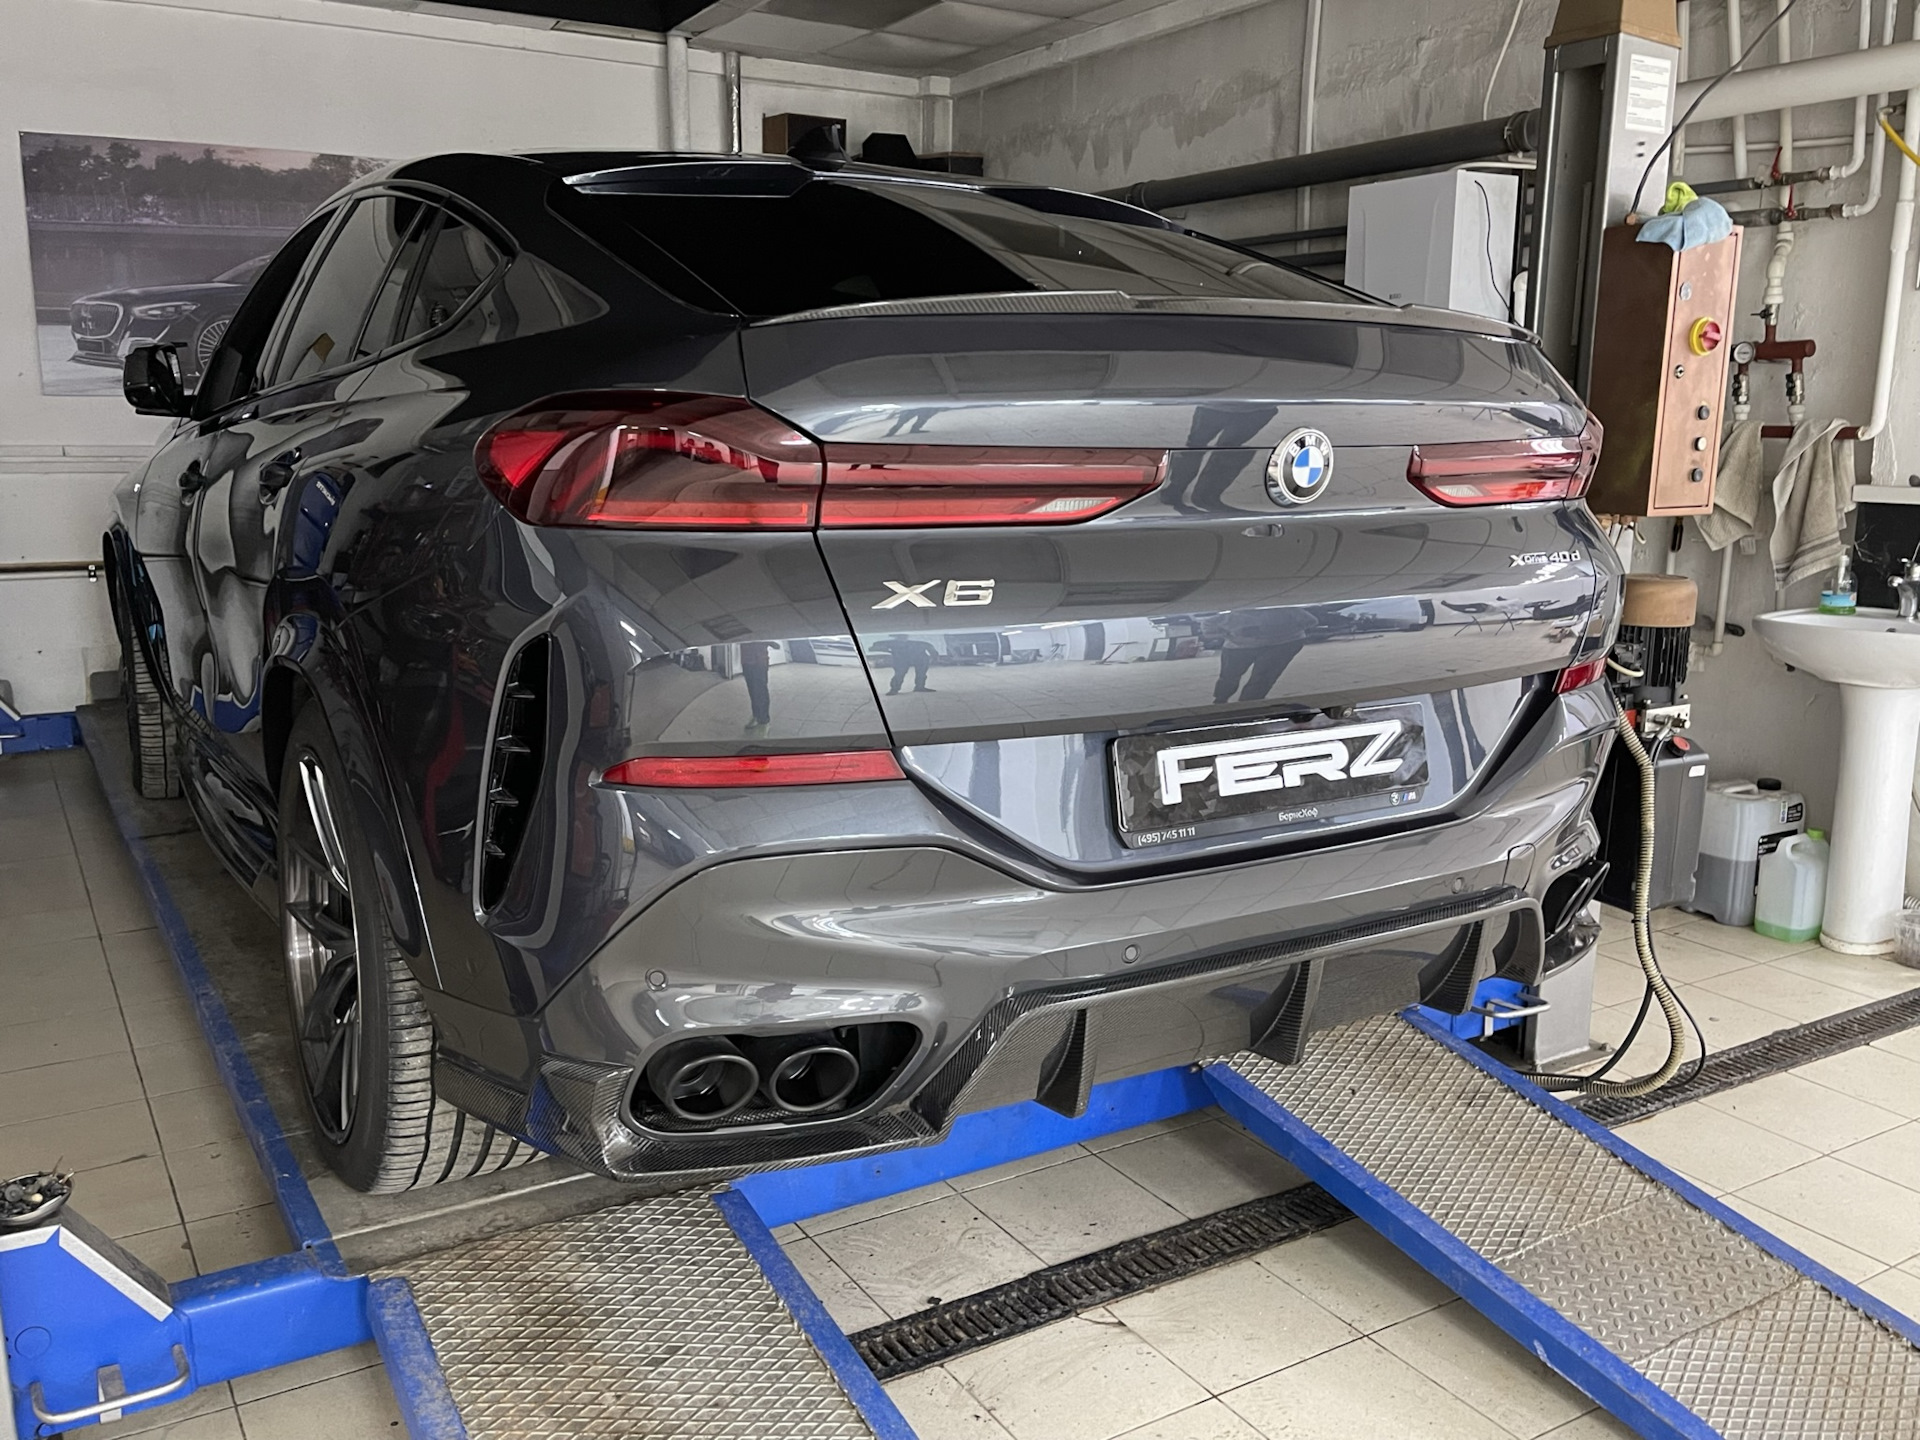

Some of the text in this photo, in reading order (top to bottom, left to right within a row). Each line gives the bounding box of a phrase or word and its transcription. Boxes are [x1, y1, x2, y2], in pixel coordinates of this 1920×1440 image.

[1288, 435, 1330, 457] BMW
[871, 578, 996, 610] X6
[1156, 719, 1404, 806] FERZ
[1137, 831, 1161, 846] (495)
